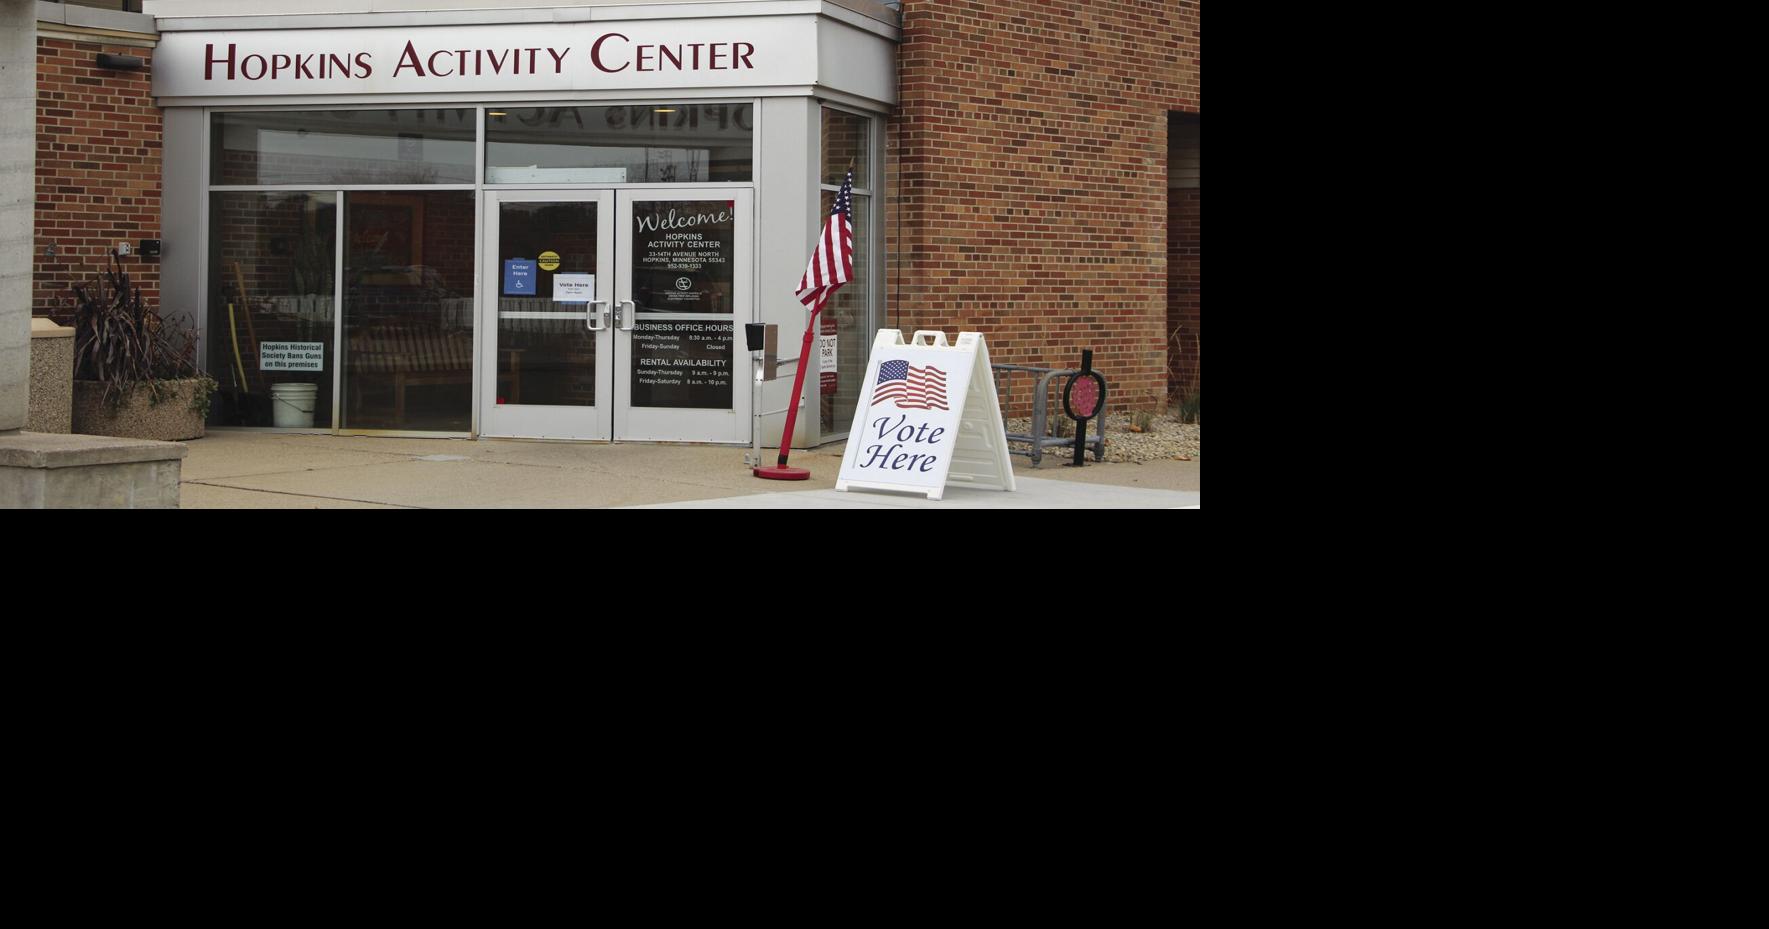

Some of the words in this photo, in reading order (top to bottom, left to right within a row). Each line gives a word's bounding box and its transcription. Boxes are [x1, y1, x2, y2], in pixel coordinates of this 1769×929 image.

[204, 43, 373, 81] HOPKINS
[392, 39, 570, 77] ACTIVITY
[590, 32, 755, 73] CENTER
[636, 206, 734, 233] Welcome!
[675, 324, 703, 332] OFFICE
[705, 324, 734, 332] HOURS
[262, 343, 289, 351] Hopkins
[290, 343, 322, 351] Historical
[640, 358, 671, 366] RENTAL
[673, 359, 727, 367] AVAILABILITY
[872, 414, 945, 444] Vote
[859, 443, 937, 472] Here
